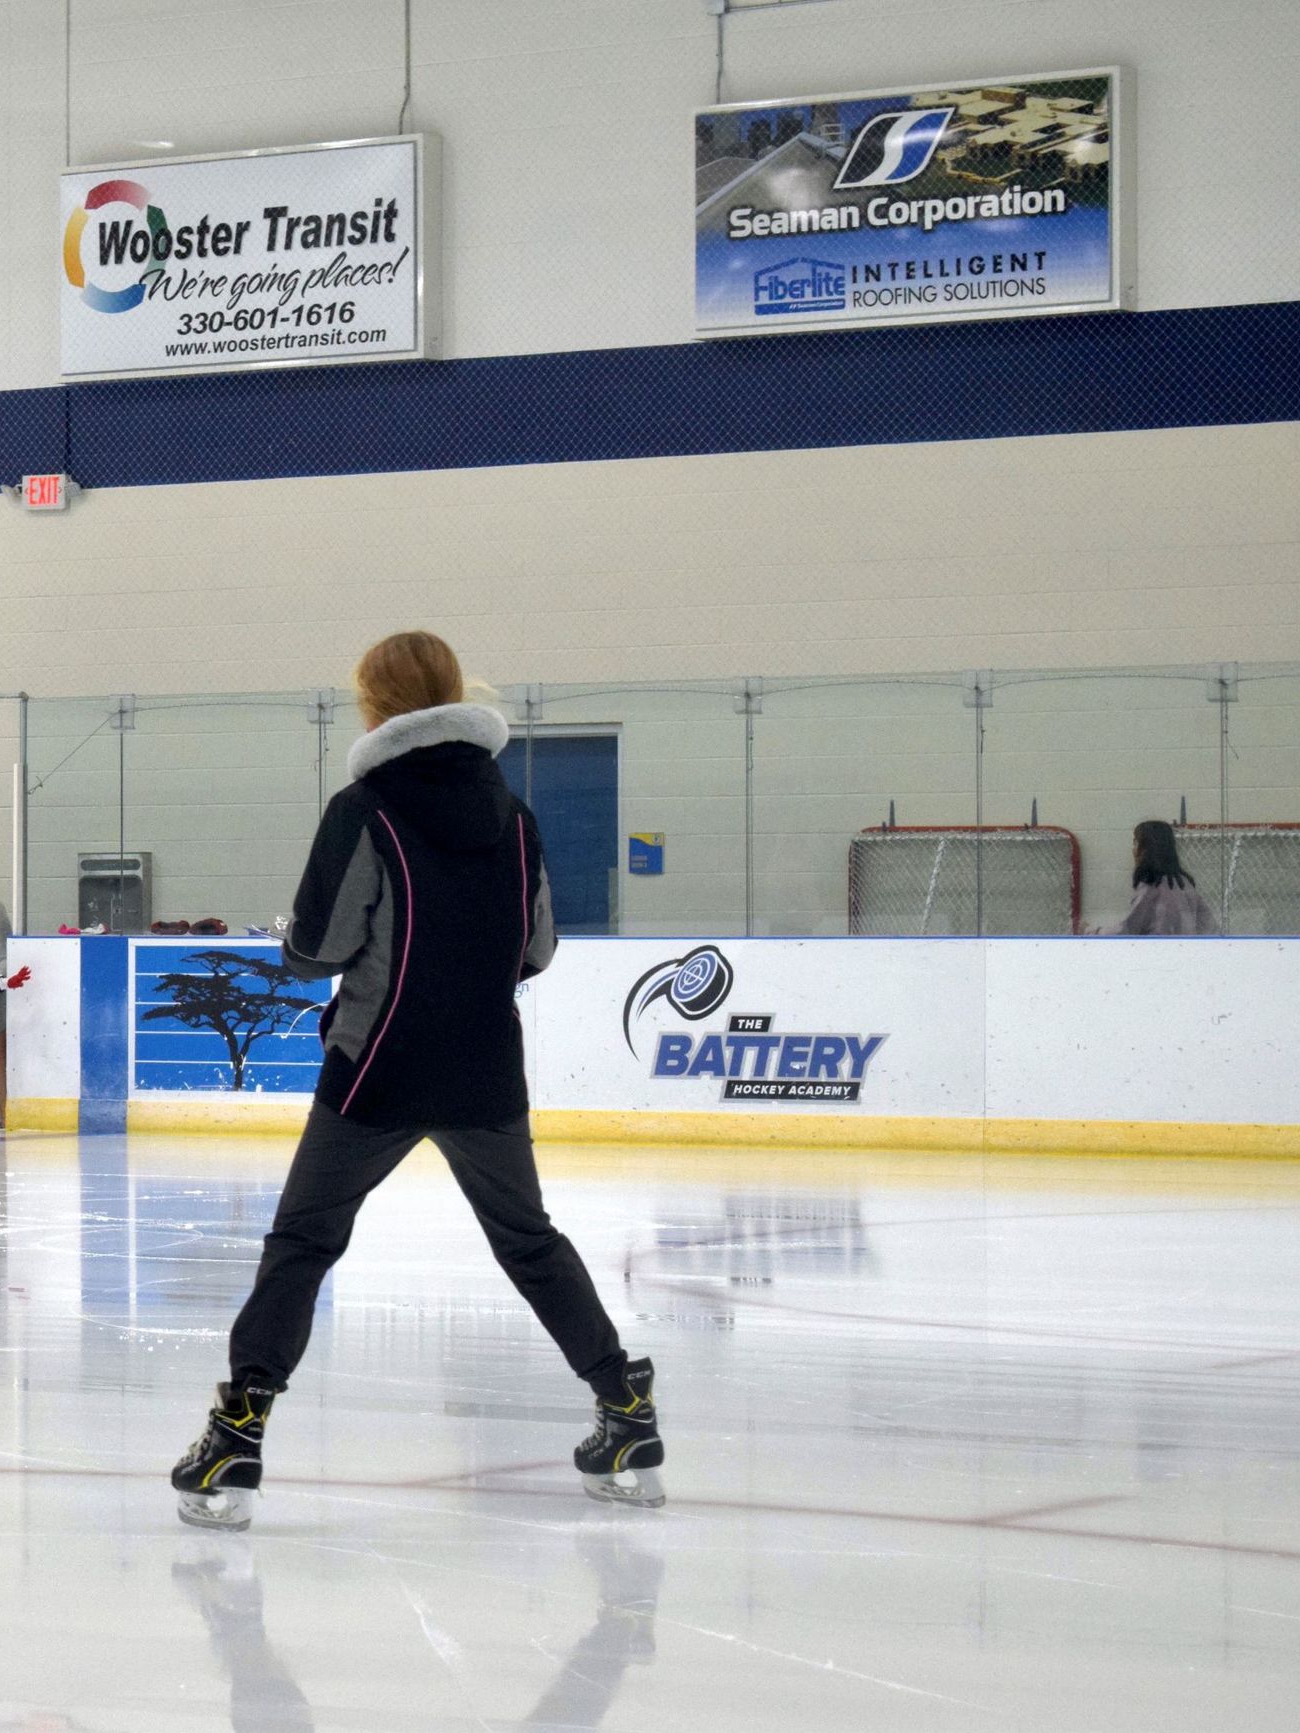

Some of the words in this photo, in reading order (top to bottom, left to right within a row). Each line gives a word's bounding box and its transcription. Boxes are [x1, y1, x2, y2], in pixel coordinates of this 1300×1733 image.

[729, 204, 859, 239] Seaman
[867, 184, 1066, 231] Corporation
[98, 214, 250, 266] Wooster
[263, 198, 399, 252] Transit
[139, 268, 227, 302] We're
[226, 263, 302, 311] going
[300, 246, 410, 300] places!
[754, 265, 845, 302] Fiberlite
[851, 251, 1047, 284] INTELLIGENT
[852, 280, 938, 308] ROOFING
[944, 277, 1046, 303] SOLUTIONS
[177, 301, 356, 336] 330-601-1616
[165, 328, 387, 357] www.woostertransit.com
[28, 477, 60, 505] EXIT
[737, 1018, 763, 1029] THE
[654, 1035, 883, 1078] BATTERY
[733, 1084, 785, 1096] HOCKEY
[788, 1085, 851, 1097] ACADEMY
